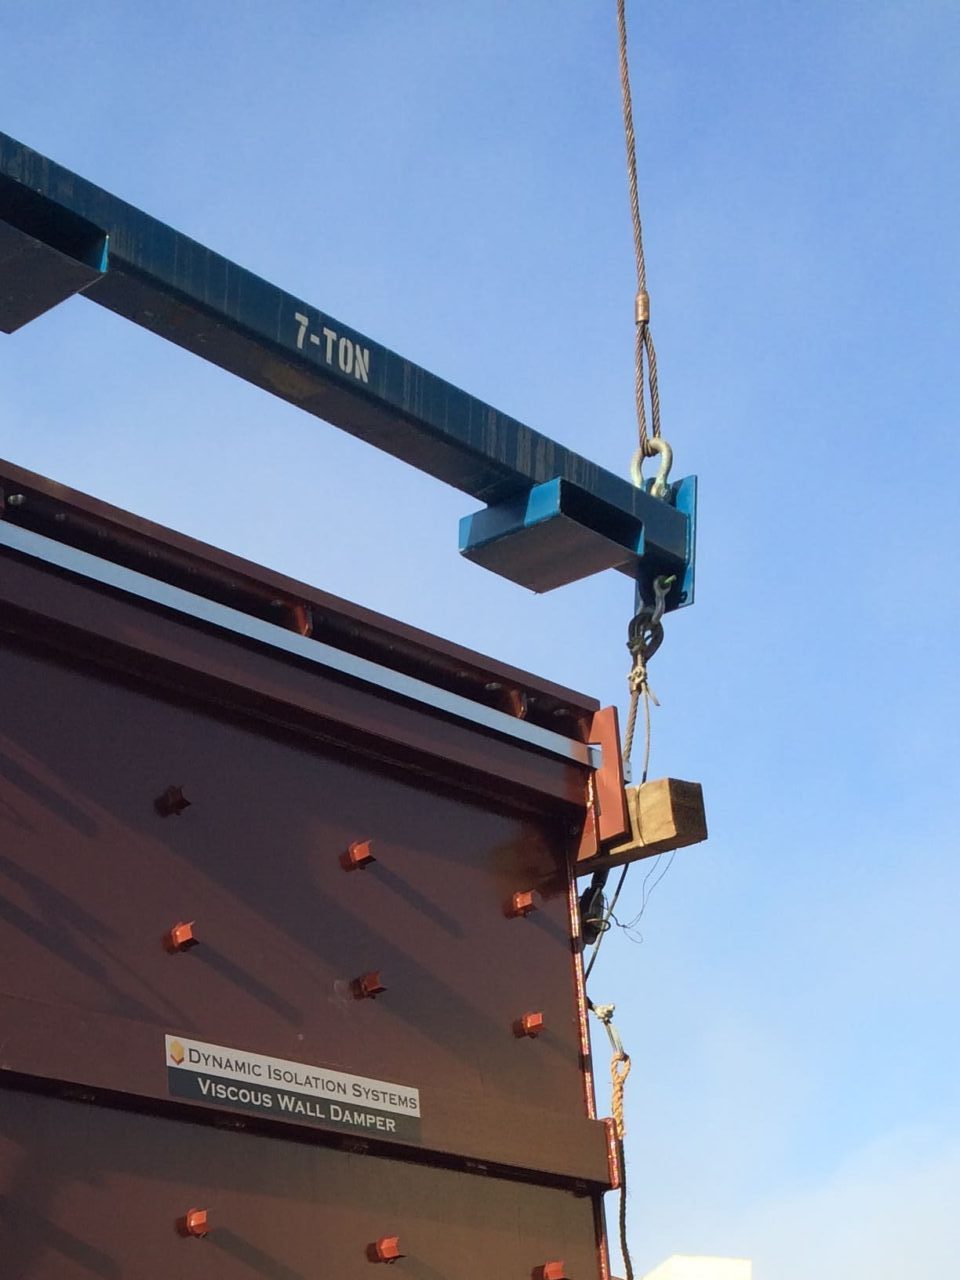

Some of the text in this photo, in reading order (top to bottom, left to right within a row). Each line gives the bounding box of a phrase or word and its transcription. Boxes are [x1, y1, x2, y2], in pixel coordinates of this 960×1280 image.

[295, 311, 370, 384] 7-TON
[188, 1048, 418, 1110] DYNAMIC ISOLATION SYSTEMS
[197, 1077, 397, 1133] VISCOUS WALL DAMPER
